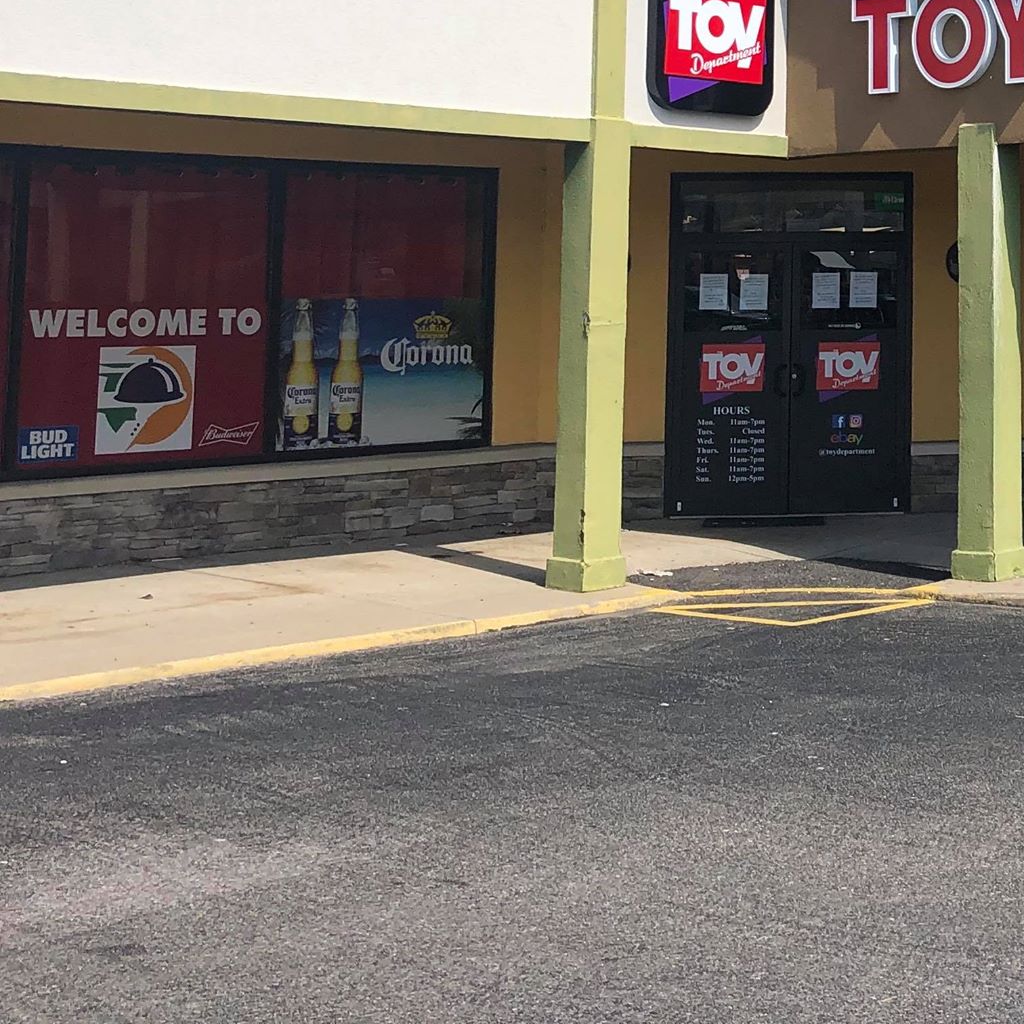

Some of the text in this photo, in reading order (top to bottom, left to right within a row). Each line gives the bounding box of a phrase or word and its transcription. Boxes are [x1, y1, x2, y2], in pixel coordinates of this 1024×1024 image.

[690, 43, 762, 75] Department
[29, 308, 262, 338] WELCOME TO
[380, 337, 474, 376] Corona
[713, 406, 751, 416] HOURS
[730, 418, 766, 427] 11am-7pm
[204, 428, 254, 442] Budweiser
[742, 427, 765, 435] Closed
[29, 429, 69, 445] BUD
[730, 437, 765, 446] 11am-7pm
[830, 432, 864, 446] ebay
[20, 443, 75, 461] LIGHT
[730, 446, 765, 455] 11am-7pm
[818, 447, 876, 458] @toydepartment
[729, 455, 765, 465] 11am-7pm
[729, 465, 765, 474] 11am-7pm
[728, 474, 765, 484] 12pm-5pm
